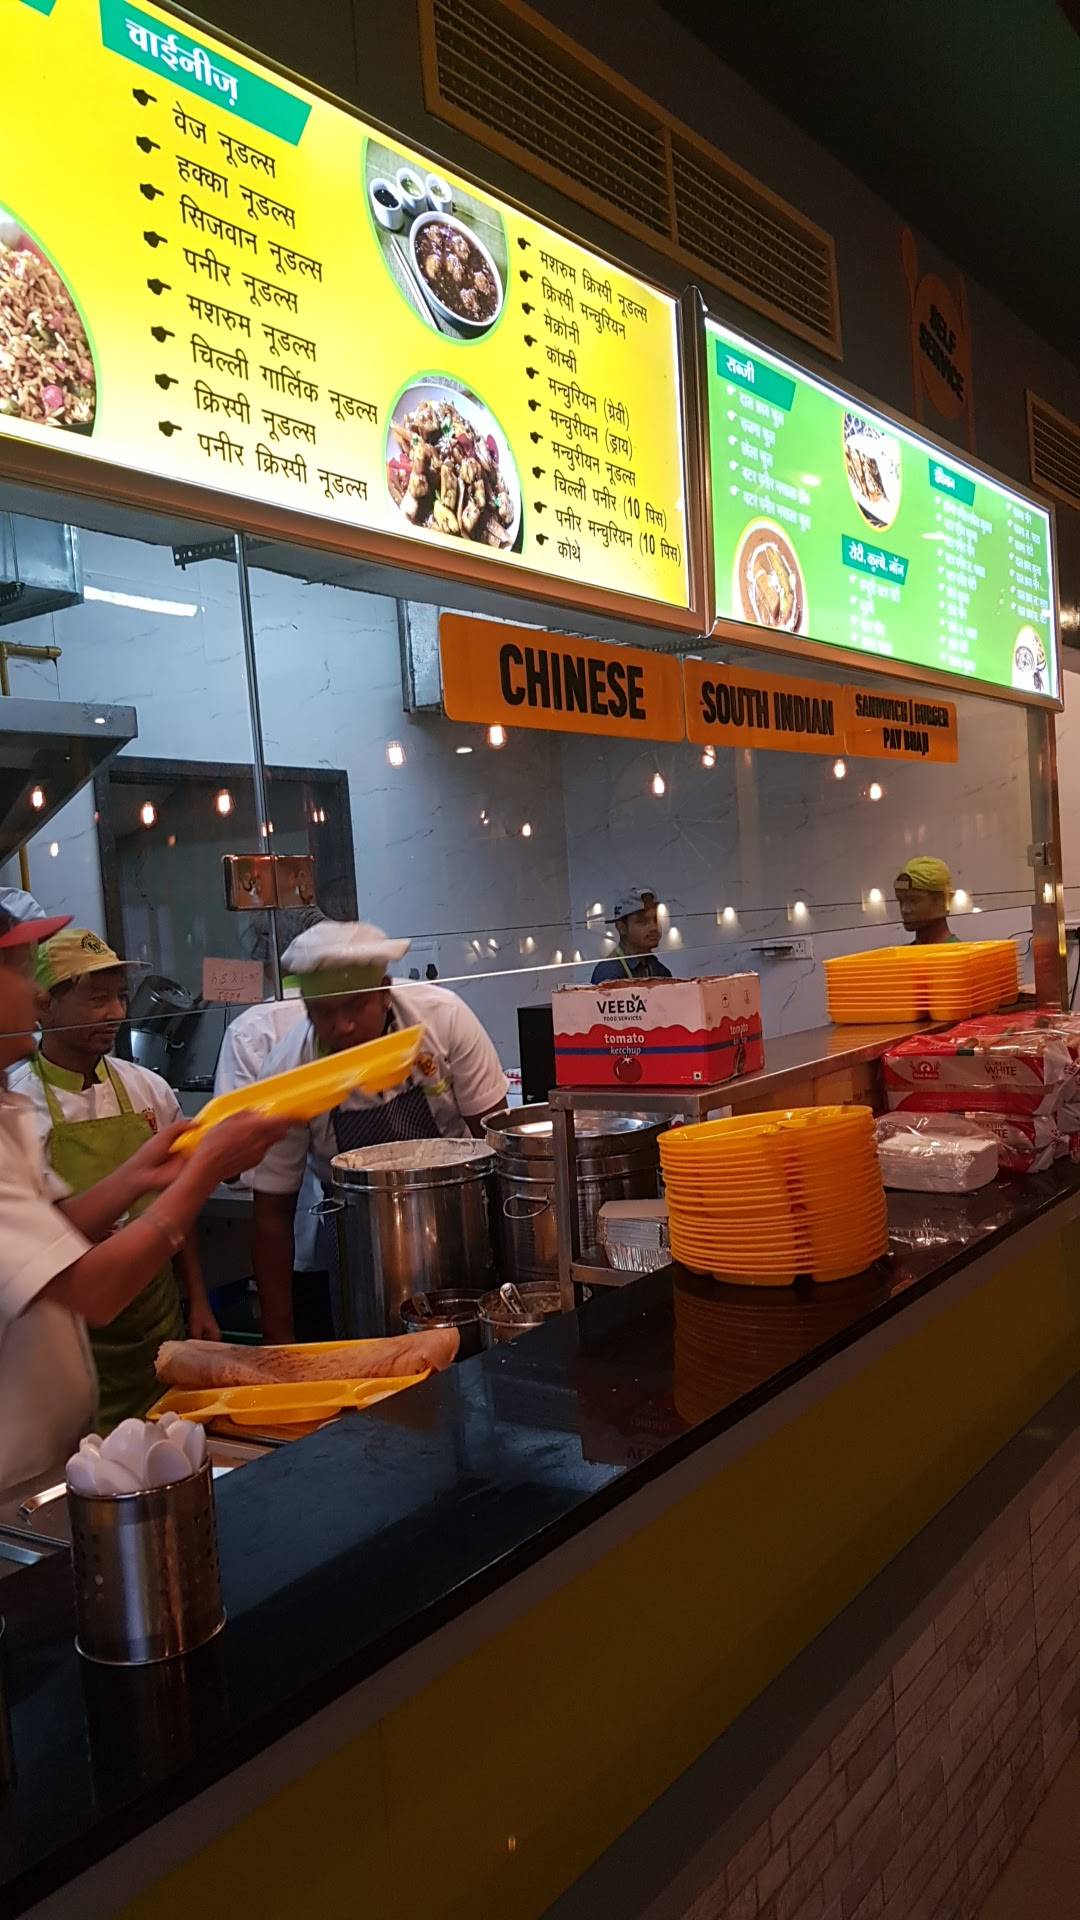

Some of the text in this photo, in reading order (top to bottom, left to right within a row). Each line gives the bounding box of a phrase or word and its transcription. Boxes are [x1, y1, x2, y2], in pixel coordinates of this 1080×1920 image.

[172, 101, 276, 178] वेज नूडल्स
[176, 155, 296, 230] हक्का नूडल्स
[179, 194, 323, 282] सिजवान नूडल्स
[183, 248, 298, 314] पनीर नूडल्स
[541, 276, 574, 313] क्रिस्पी
[582, 268, 612, 304] क्रिस्पी
[617, 293, 648, 323] नूडल्स
[261, 323, 316, 362] नूडल्स
[543, 308, 580, 346] मेक्रोनी
[190, 333, 249, 380] चिल्ली
[328, 389, 378, 424] नूडल्स
[194, 379, 316, 445] क्रिस्पी नूडल्स
[197, 431, 368, 501] पनीर क्रिस्पी नूडल्स
[605, 461, 636, 487] नूडल्स
[554, 469, 587, 501] चिल्ली
[592, 486, 617, 511] पनीर
[623, 495, 640, 520] (10
[555, 506, 582, 532] पनीर
[639, 531, 656, 558] (10
[499, 643, 646, 720] CHINESE
[701, 681, 834, 736] SOUTH INDIAN
[855, 693, 950, 727] SANDWICH BURGER
[883, 727, 902, 750] PAV
[596, 998, 647, 1015] VEEBA
[604, 1032, 645, 1044] tomato
[610, 1045, 642, 1057] ketchup
[984, 1064, 1017, 1076] WHITE
